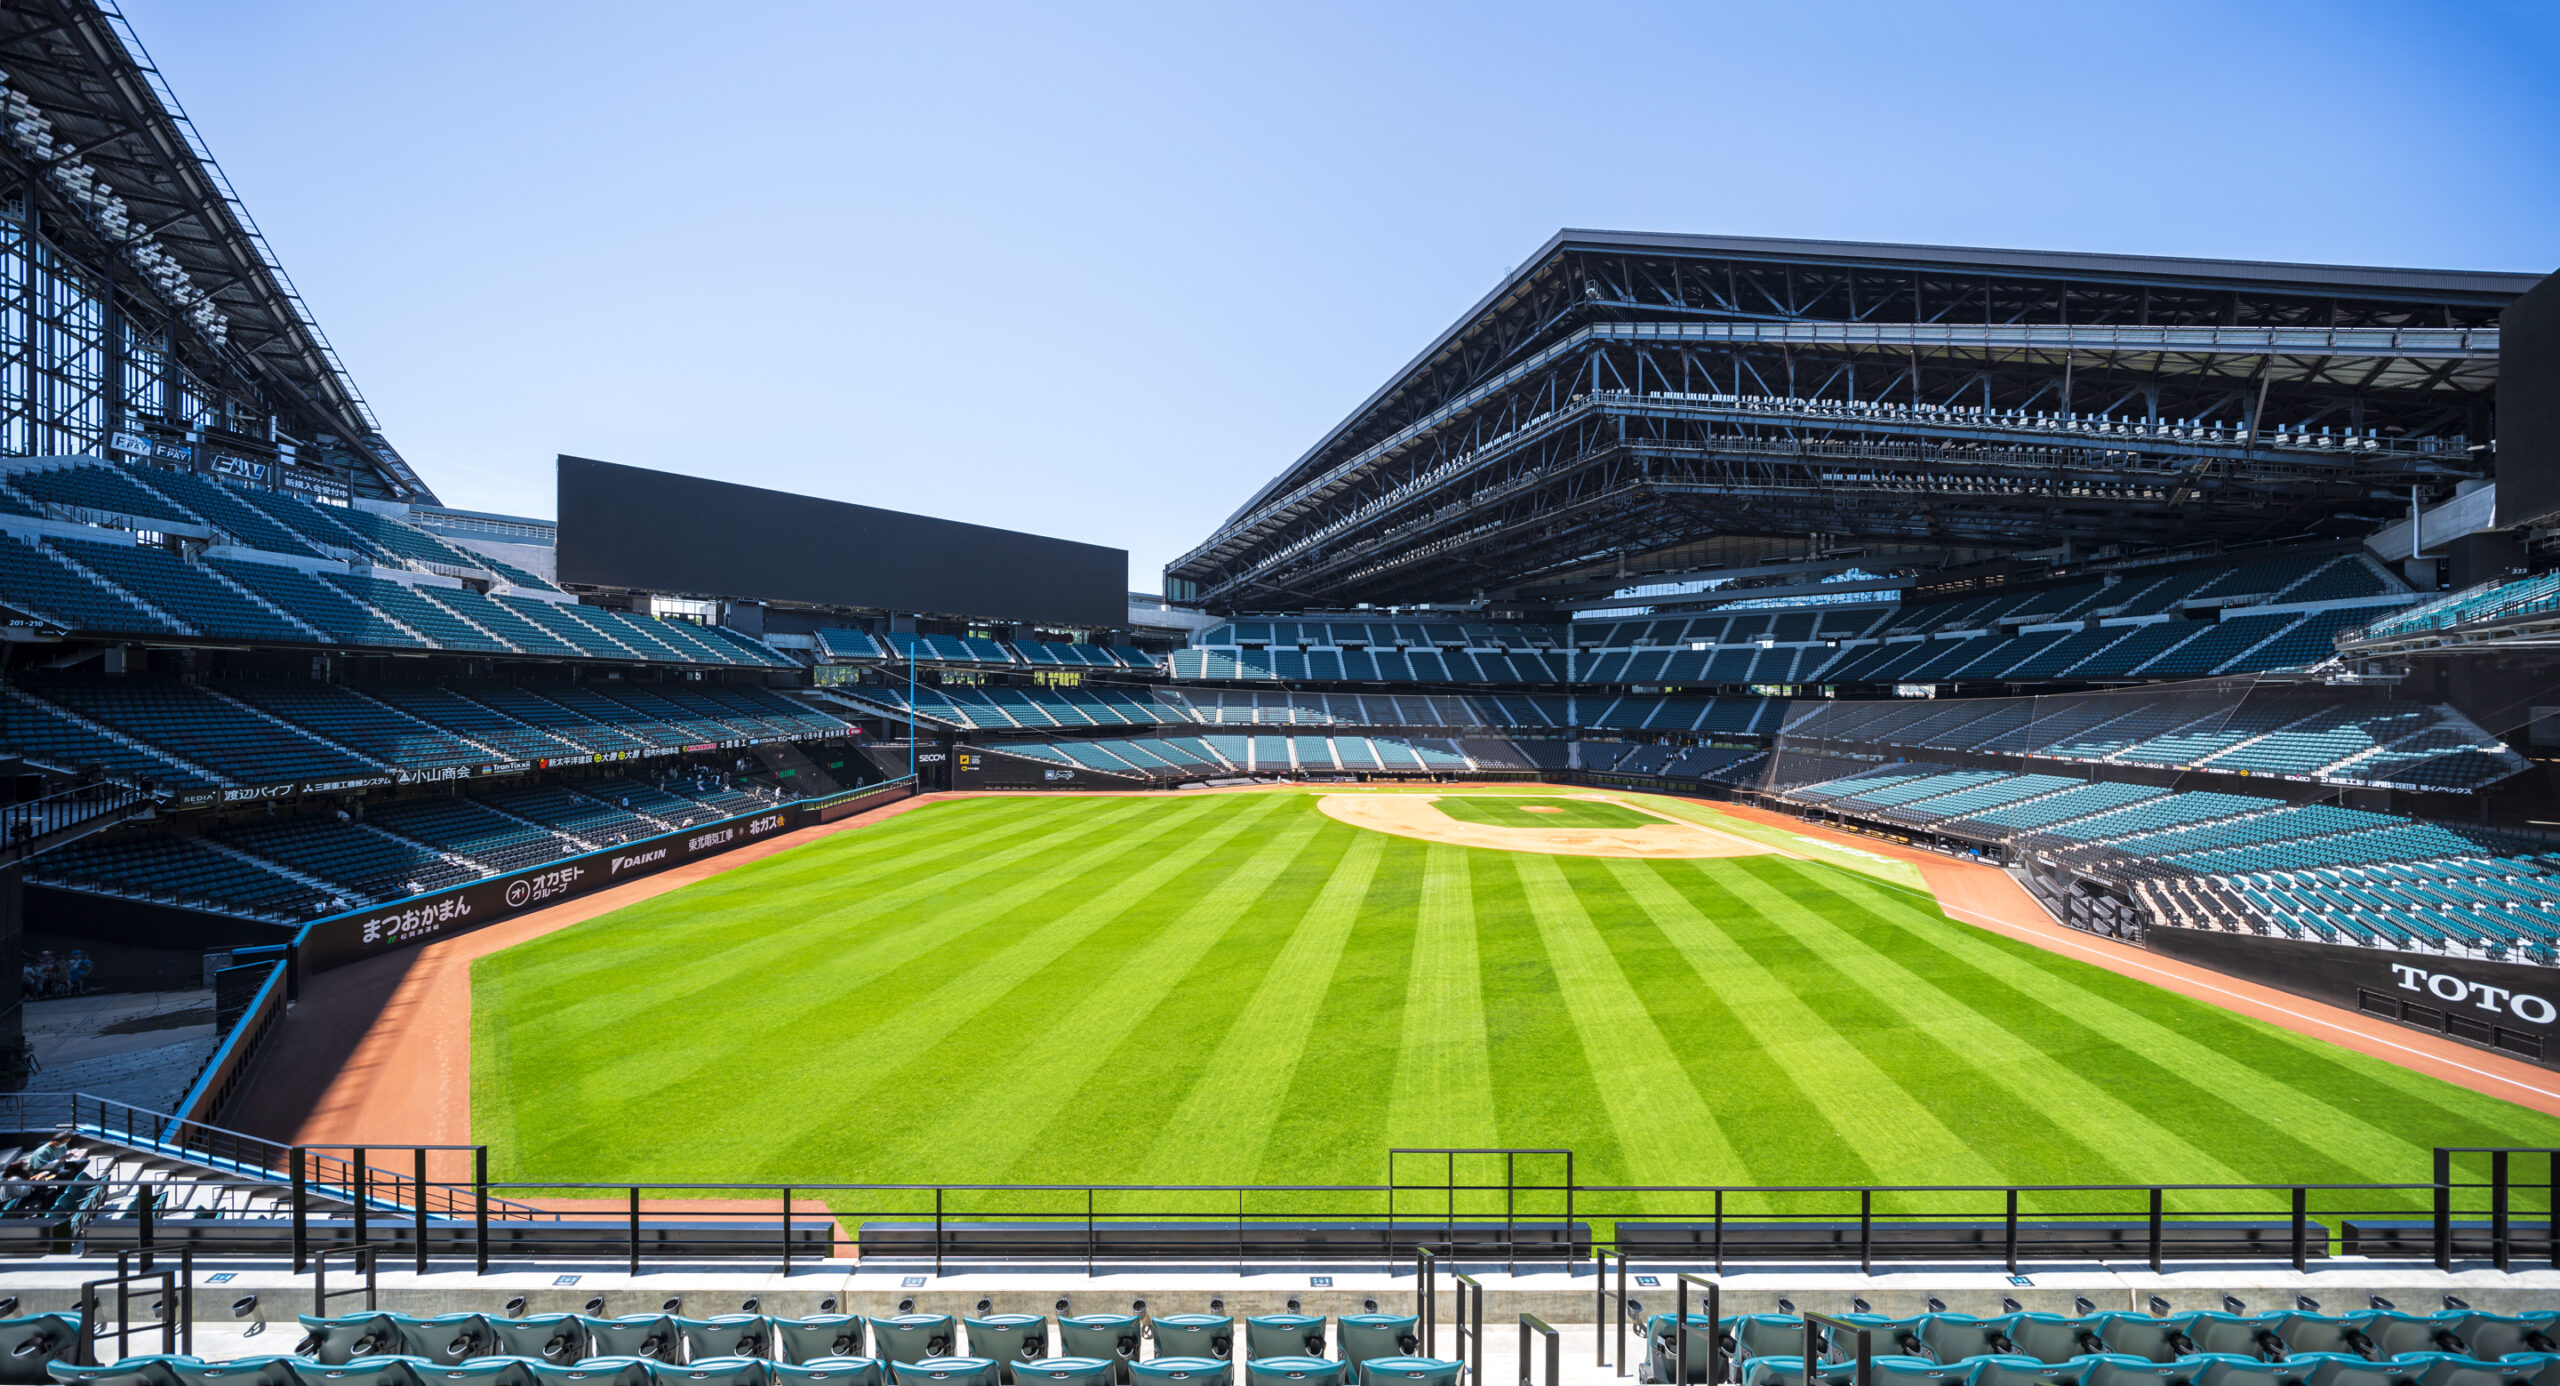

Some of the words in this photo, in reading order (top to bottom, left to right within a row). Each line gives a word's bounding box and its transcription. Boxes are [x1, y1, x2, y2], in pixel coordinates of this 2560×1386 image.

[126, 442, 147, 452] PAY
[166, 451, 187, 461] PAY
[285, 478, 348, 498] 新規入会受付中
[549, 756, 592, 767] 新太平洋建設
[919, 753, 946, 762] SECOM
[412, 765, 471, 784] 小山商会
[224, 784, 294, 802] 渡辺パイプ
[314, 778, 391, 792] 三菱重工機械システム
[750, 816, 777, 835] 北ガス
[689, 828, 734, 852] 東光電気工事
[623, 848, 666, 869] DAIKIN
[532, 865, 585, 892] オカモト
[532, 883, 568, 901] グループ
[362, 895, 471, 943] まつおかまん
[2392, 963, 2557, 1024] TOTO
